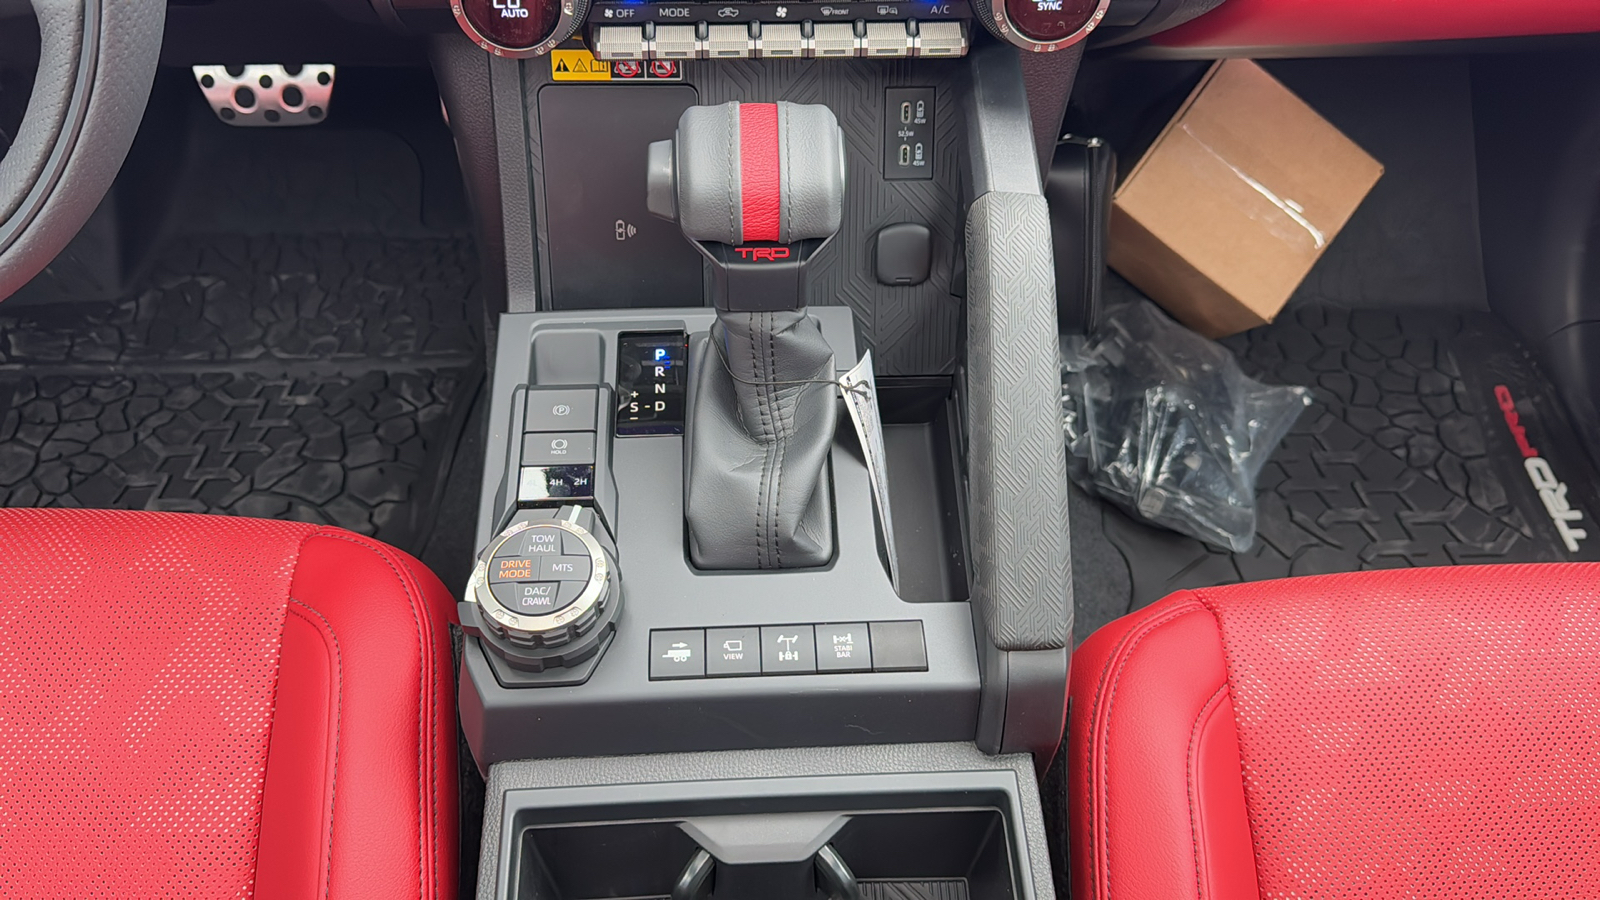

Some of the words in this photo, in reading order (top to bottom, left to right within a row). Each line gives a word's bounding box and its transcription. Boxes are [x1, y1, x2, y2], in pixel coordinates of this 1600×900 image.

[930, 5, 950, 14] A/C
[1037, 1, 1063, 11] SYNC
[501, 9, 529, 18] AUTO
[616, 9, 635, 18] OFF
[659, 8, 689, 17] MODE
[734, 247, 790, 261] TRD
[654, 348, 666, 361] P
[654, 366, 665, 377] R
[654, 383, 666, 394] N
[1523, 456, 1587, 552] TRD
[531, 534, 555, 543] TOW
[528, 544, 556, 552] HAUL
[500, 559, 532, 569] DRIVE
[552, 563, 574, 572] MTS
[499, 569, 532, 579] MODE
[524, 586, 552, 596] DAC/
[522, 597, 551, 605] CRAWL
